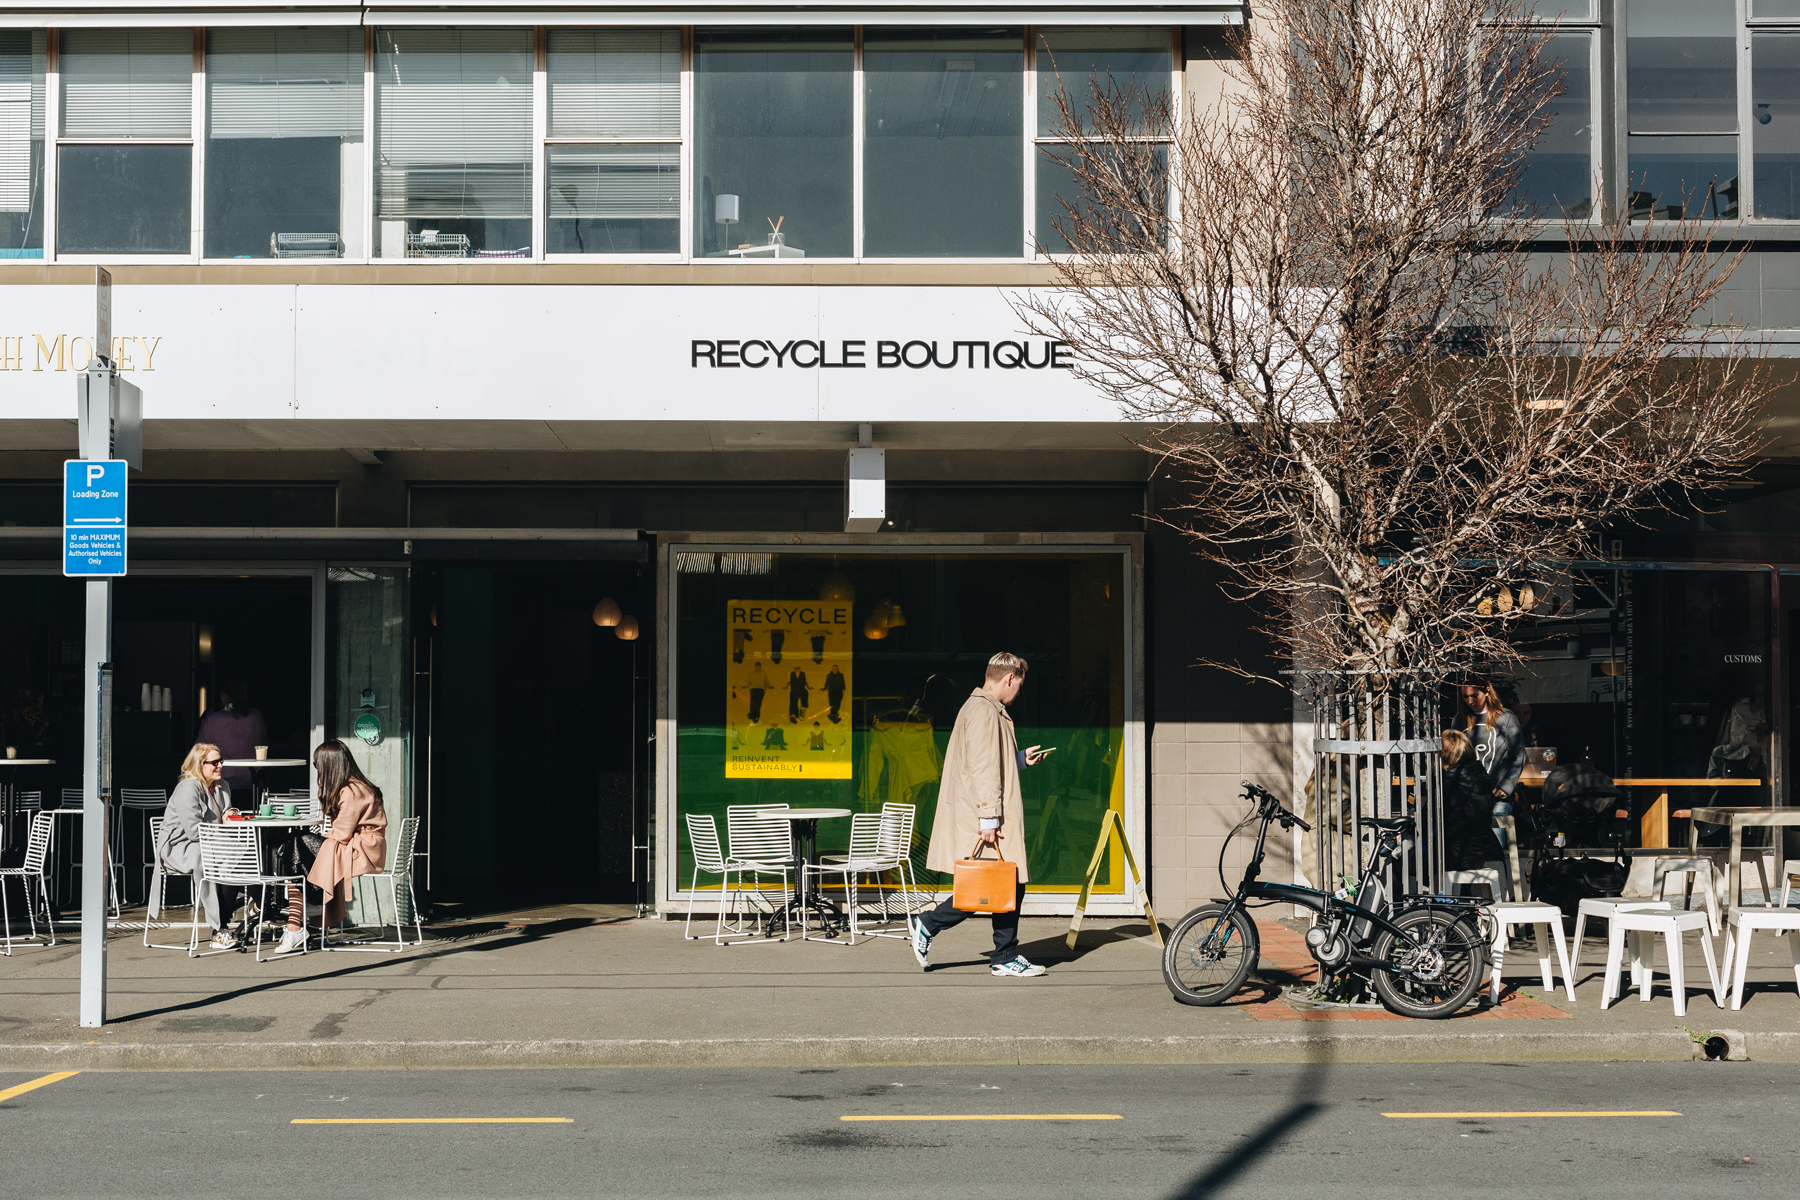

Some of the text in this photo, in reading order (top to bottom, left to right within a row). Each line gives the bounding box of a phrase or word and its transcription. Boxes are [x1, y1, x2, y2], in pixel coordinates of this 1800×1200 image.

[691, 339, 1075, 370] RECYCLE BOUTIQUE
[87, 464, 105, 487] P
[72, 490, 119, 499] Loading Zone
[88, 558, 102, 566] Only
[733, 608, 847, 624] RECYCLE
[1724, 654, 1762, 664] CUSTOMS
[732, 755, 780, 763] REINVENT
[732, 763, 798, 771] SUSTAINABLY
